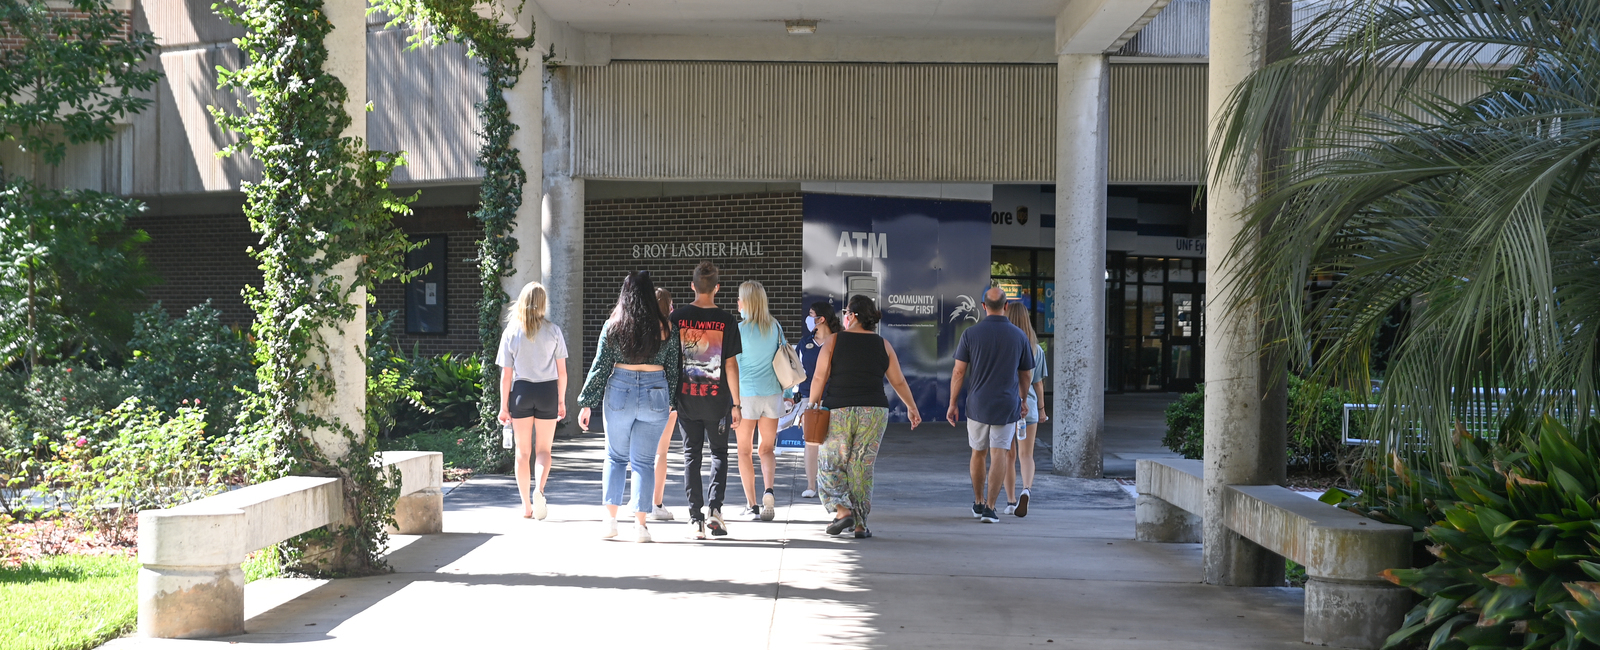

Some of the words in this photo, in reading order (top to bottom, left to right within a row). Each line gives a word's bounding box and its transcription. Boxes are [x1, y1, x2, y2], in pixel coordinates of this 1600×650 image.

[632, 244, 640, 259] 8
[643, 243, 668, 258] ROY
[671, 242, 727, 257] LASSITER
[730, 241, 764, 256] HALL
[836, 231, 888, 259] ATM
[1176, 238, 1193, 251] UNF
[888, 294, 935, 304] COMMUNITY
[915, 305, 935, 315] FIRST
[678, 319, 726, 331] FALL/WINTER
